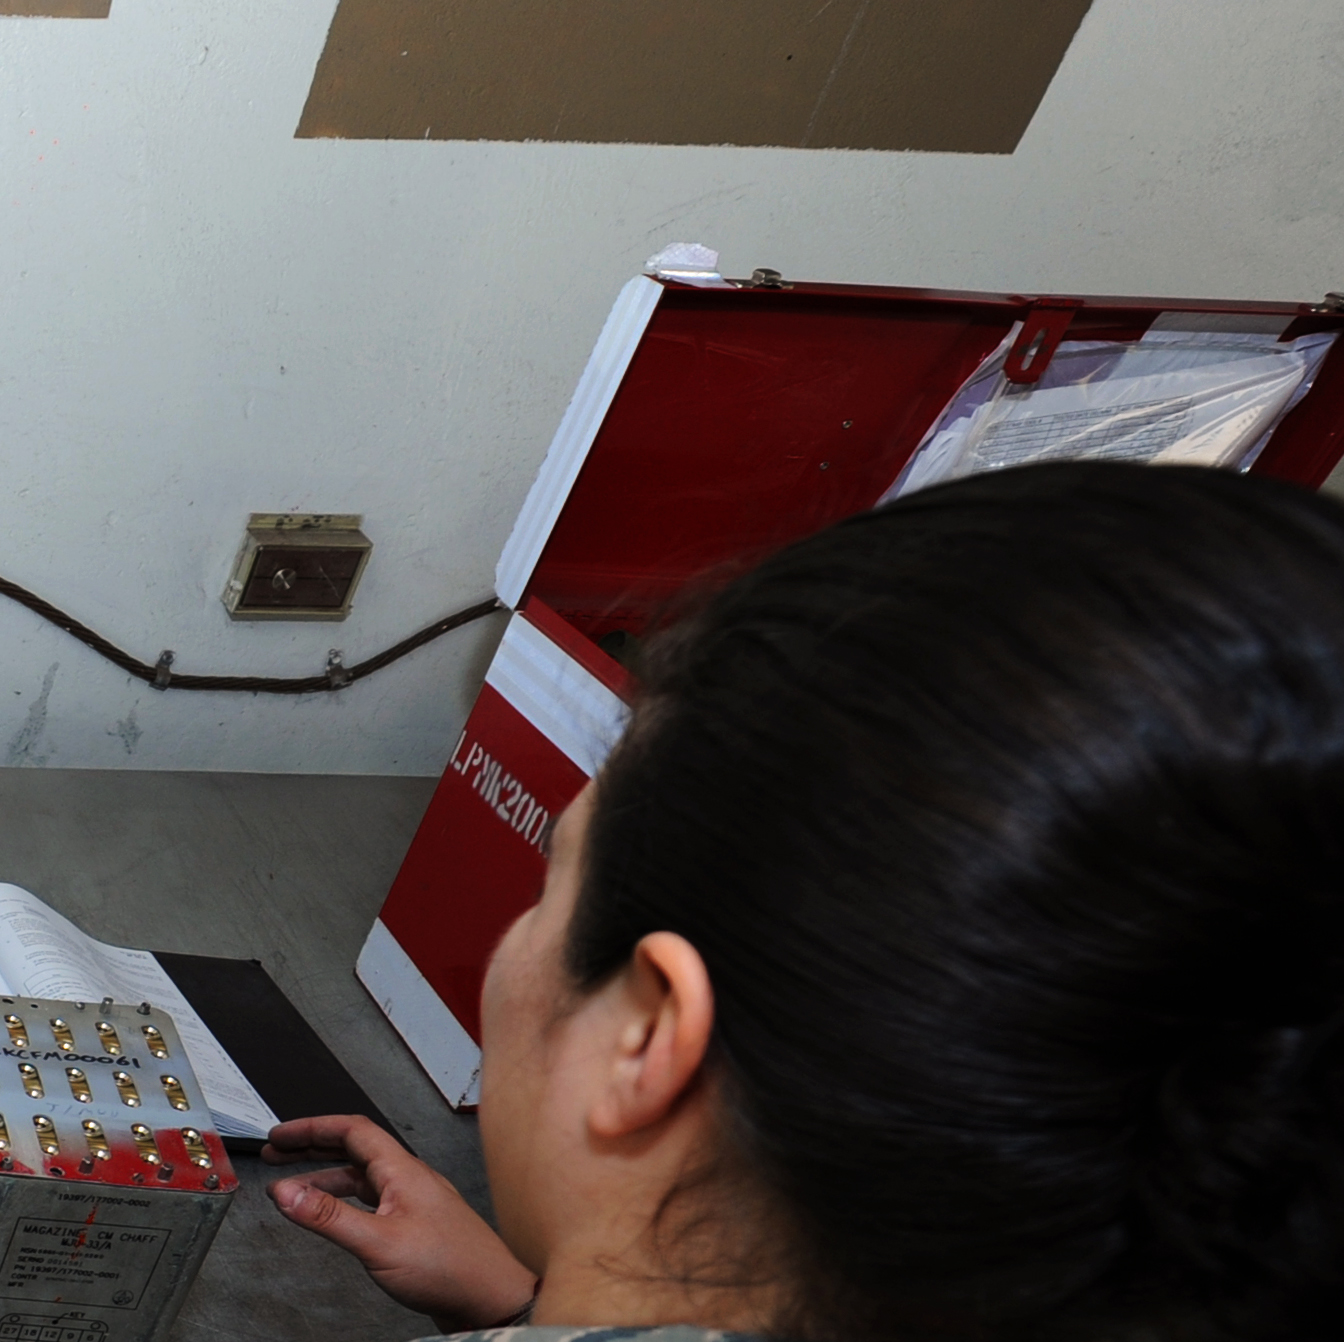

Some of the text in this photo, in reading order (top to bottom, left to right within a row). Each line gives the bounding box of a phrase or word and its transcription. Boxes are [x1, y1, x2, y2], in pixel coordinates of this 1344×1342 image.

[97, 1231, 113, 1240] CM
[120, 1232, 159, 1244] CHAFF
[2, 1327, 18, 1335] 27
[44, 1331, 57, 1339] 12
